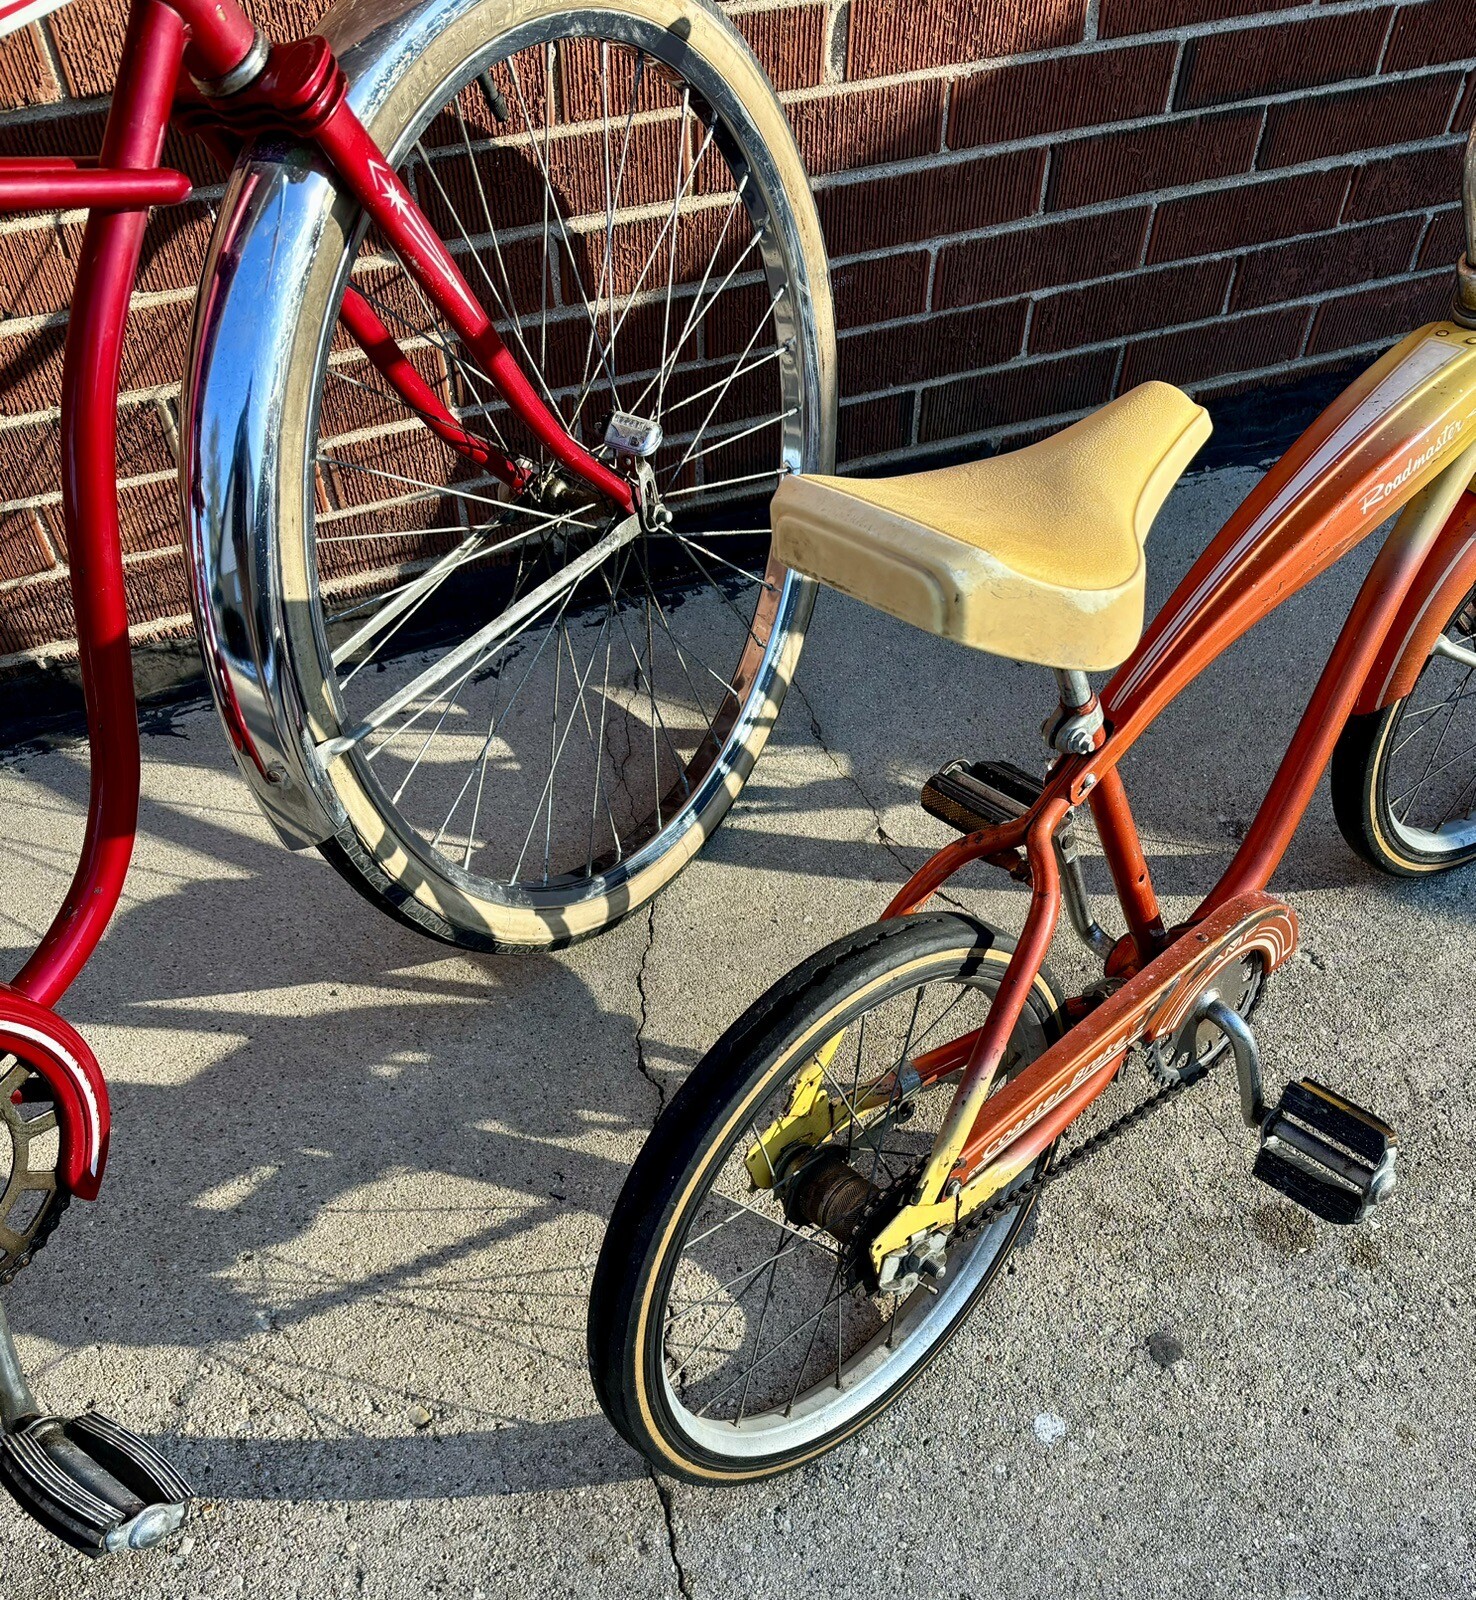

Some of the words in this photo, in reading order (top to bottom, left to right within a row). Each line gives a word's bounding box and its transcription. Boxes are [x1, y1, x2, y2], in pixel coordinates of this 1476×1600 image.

[394, 7, 505, 123] UNIROYAL
[1357, 419, 1465, 515] Roadmaster
[1207, 923, 1260, 972] AMF
[981, 1083, 1068, 1160] Coaster
[1070, 1034, 1128, 1087] Brake
